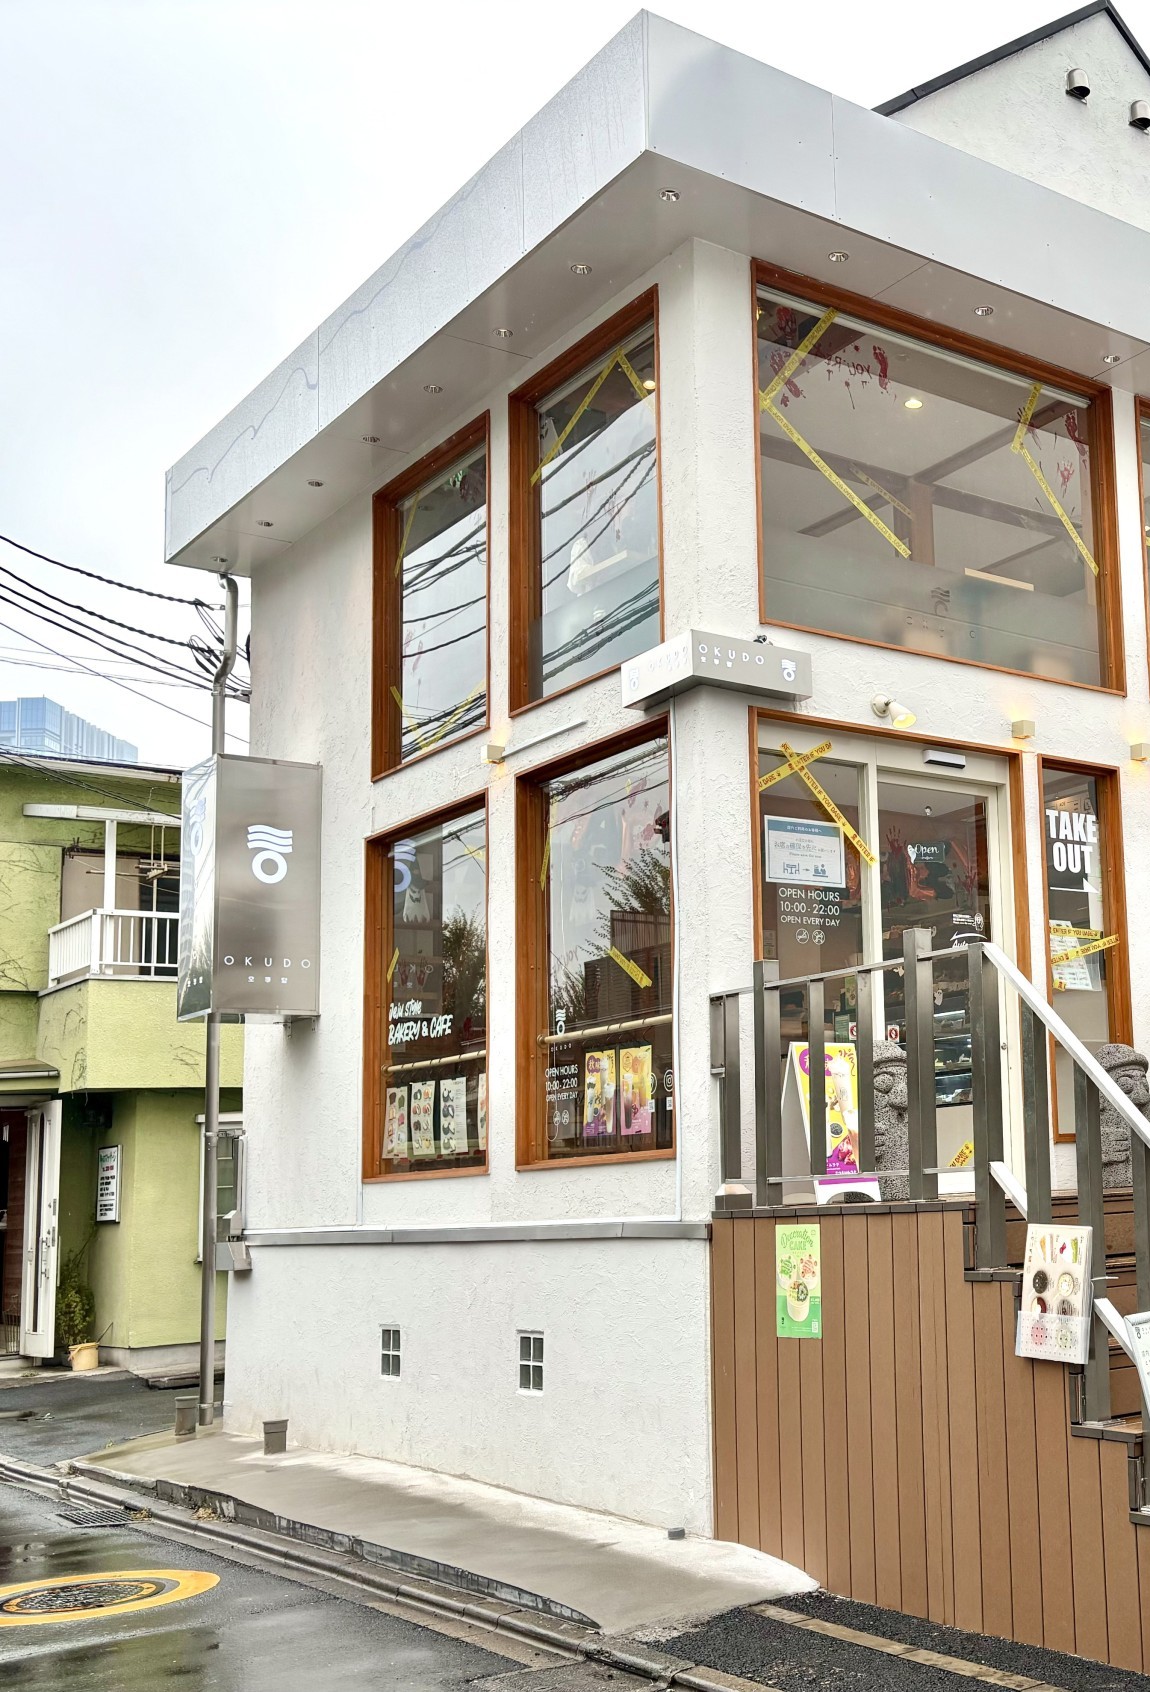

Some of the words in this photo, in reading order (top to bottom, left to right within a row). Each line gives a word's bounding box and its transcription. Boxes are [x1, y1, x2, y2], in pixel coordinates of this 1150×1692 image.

[698, 644, 764, 666] OKUDO
[808, 750, 815, 758] IF
[813, 744, 826, 755] YOU
[762, 773, 776, 785] DARE
[803, 772, 819, 791] ENTER
[822, 794, 833, 808] YOU
[831, 806, 842, 822] DARE
[1045, 808, 1098, 843] TAKE
[856, 840, 871, 858] ENTER
[915, 843, 940, 855] Open
[1053, 841, 1093, 874] OUT
[778, 887, 805, 899] OPEN
[808, 890, 840, 902] HOURS
[780, 901, 806, 913] 10:00
[812, 904, 840, 916] 22:00
[780, 915, 801, 924] OPEN
[803, 916, 825, 926] EVERY
[825, 918, 840, 926] DAY
[1090, 942, 1101, 950] YOU
[224, 955, 311, 969] OKUDO
[388, 1020, 420, 1046] BAKERY
[422, 1020, 428, 1037] &
[430, 1014, 454, 1038] CAFE
[545, 1066, 560, 1078] OPEN
[560, 1064, 578, 1074] HOURS
[546, 1080, 560, 1092] 10:00
[562, 1077, 578, 1089] 22:00
[546, 1094, 558, 1102] OPEN
[780, 1229, 814, 1248] Decoration
[789, 1240, 807, 1250] CAKE
